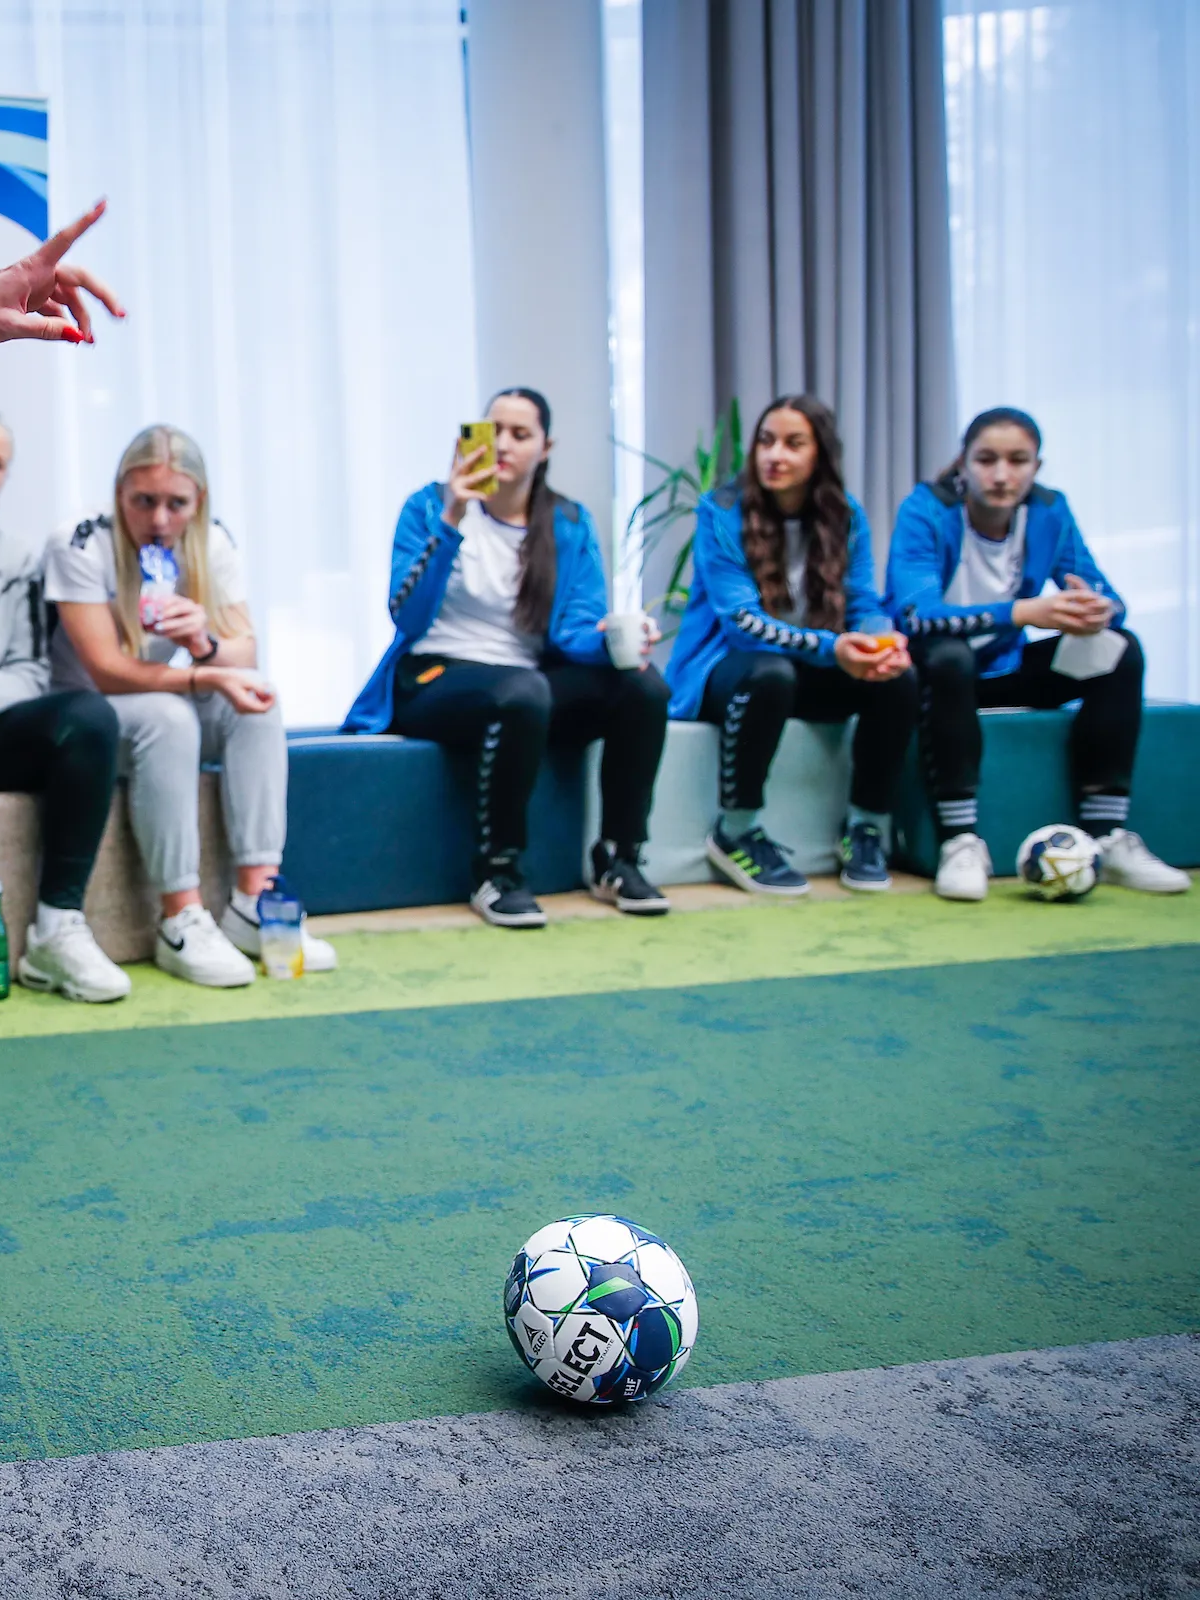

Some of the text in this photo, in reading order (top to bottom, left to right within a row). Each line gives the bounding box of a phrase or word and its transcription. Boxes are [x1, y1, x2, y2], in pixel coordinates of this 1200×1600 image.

[532, 1331, 548, 1355] SELECT
[597, 1339, 615, 1365] ULTIMATE
[547, 1321, 610, 1397] SELECT
[623, 1378, 636, 1396] EHF
